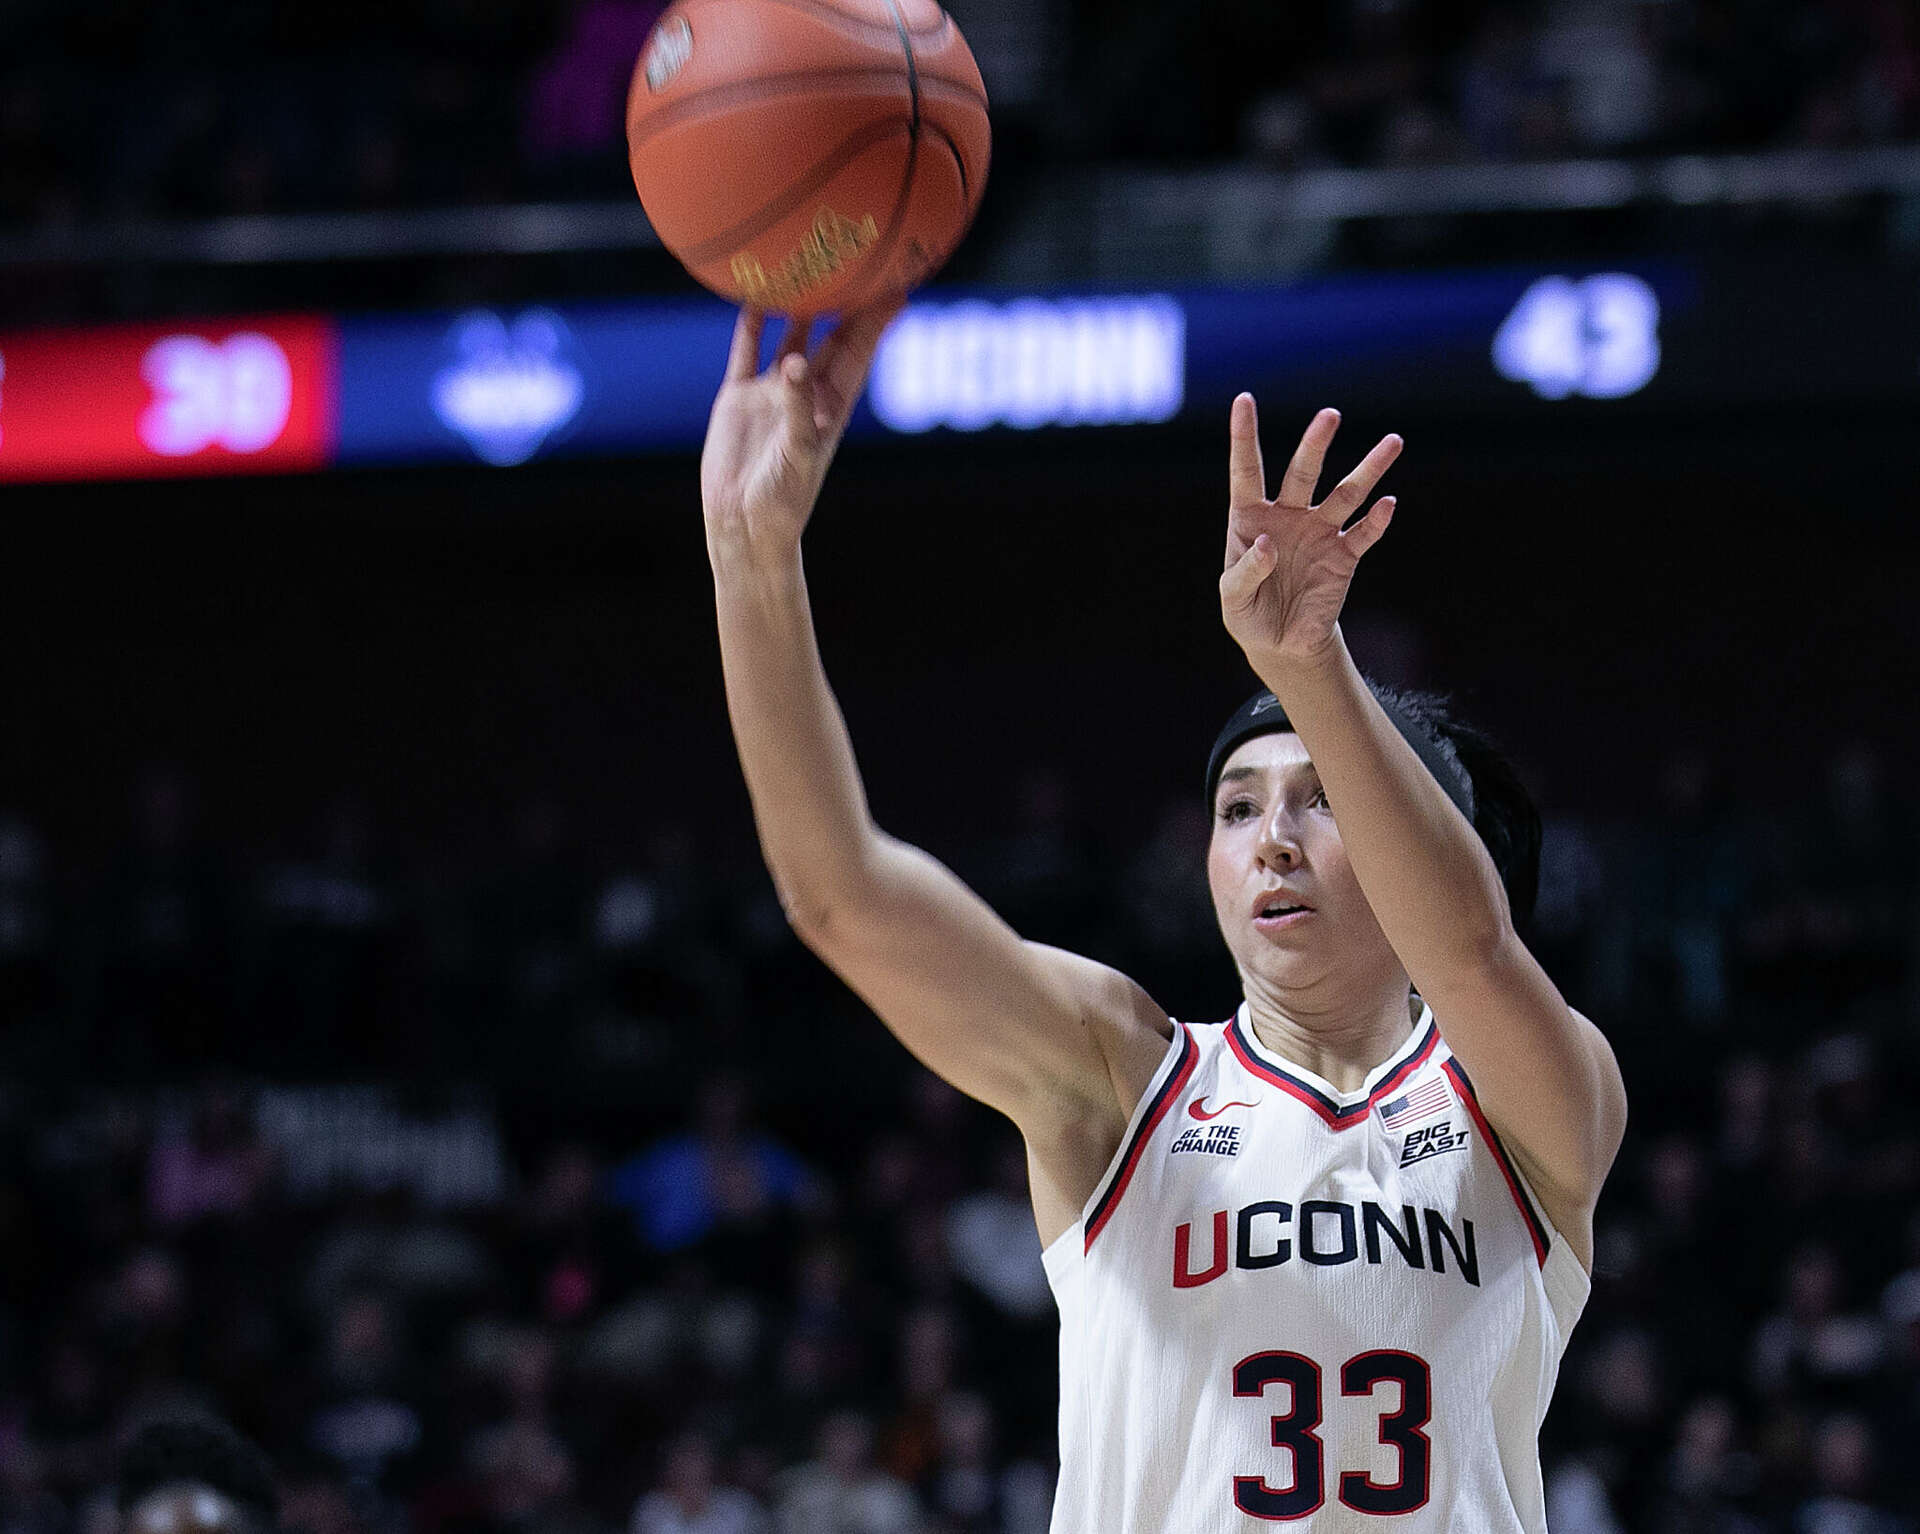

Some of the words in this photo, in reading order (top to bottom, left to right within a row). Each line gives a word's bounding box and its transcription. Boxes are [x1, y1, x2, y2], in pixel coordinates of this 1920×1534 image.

[1492, 273, 1660, 399] 43
[1171, 1139, 1241, 1156] CHANGE
[1180, 1126, 1205, 1140] BE
[1208, 1125, 1241, 1140] THE
[1400, 1131, 1469, 1162] EAST
[1404, 1121, 1451, 1148] BIG
[1173, 1201, 1480, 1288] UCONN
[1232, 1349, 1432, 1521] 33
